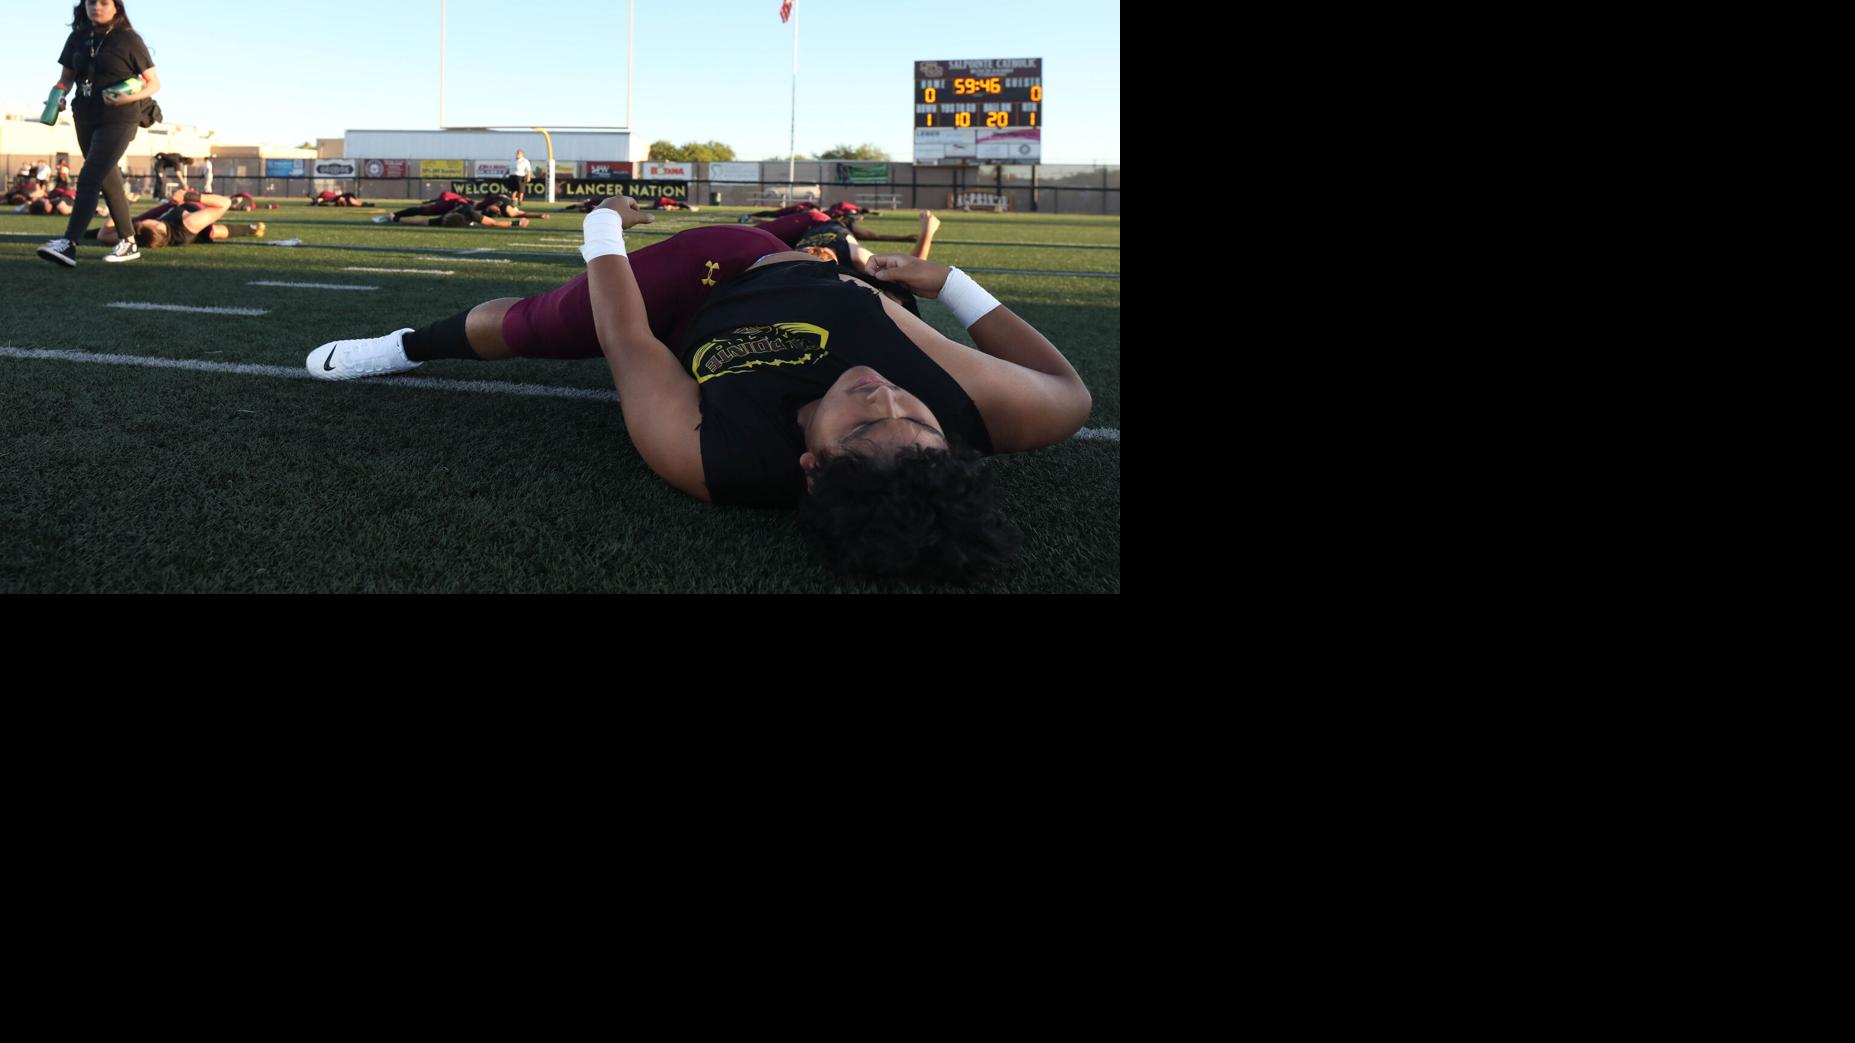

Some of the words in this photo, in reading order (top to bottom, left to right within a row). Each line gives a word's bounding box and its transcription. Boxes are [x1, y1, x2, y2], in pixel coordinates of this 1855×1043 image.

[954, 77, 1001, 94] 59:46
[924, 87, 936, 103] 0
[1030, 85, 1042, 102] 0
[926, 113, 933, 126] 1
[955, 112, 971, 127] 10
[986, 112, 1008, 127] 20
[1029, 112, 1036, 126] 1
[453, 183, 511, 194] WELCOM
[527, 183, 545, 194] TO
[566, 183, 623, 196] LANCER
[629, 185, 686, 197] NATION
